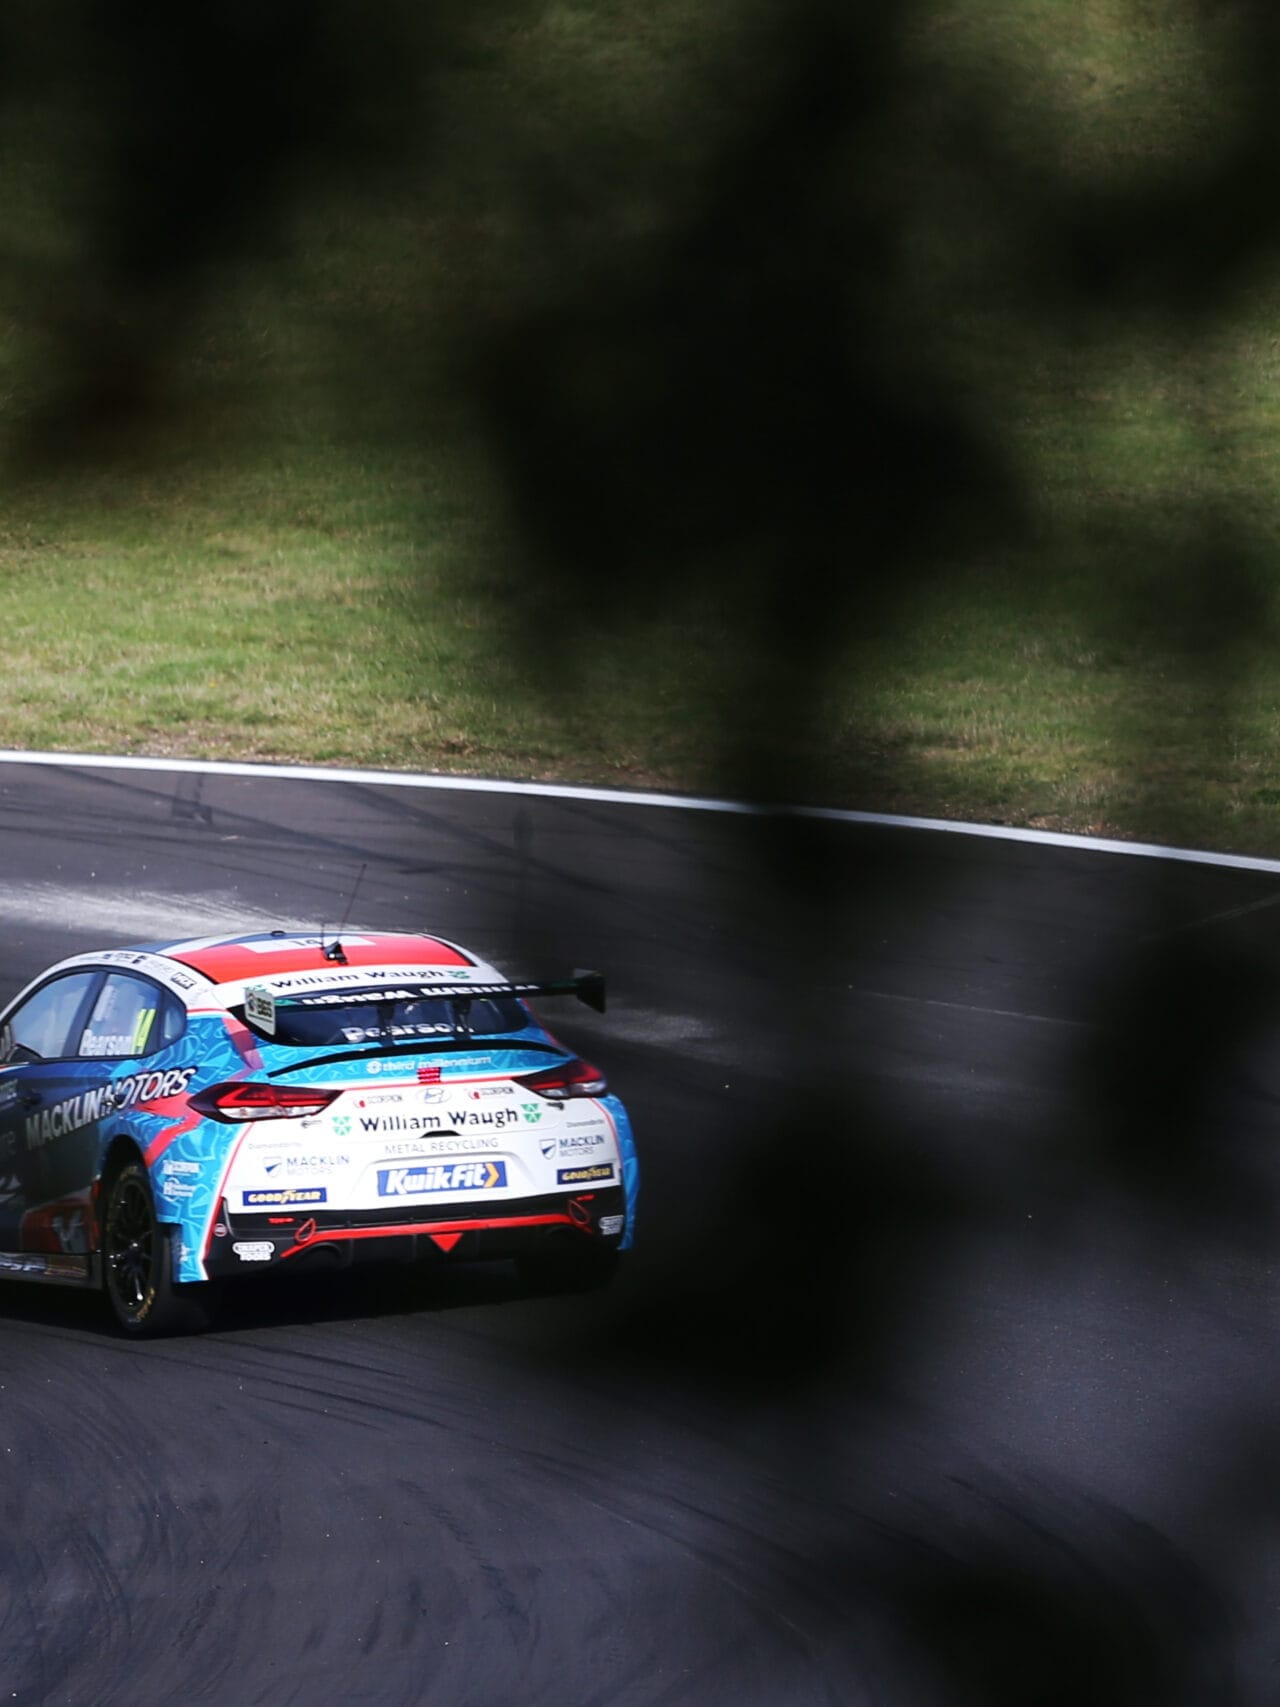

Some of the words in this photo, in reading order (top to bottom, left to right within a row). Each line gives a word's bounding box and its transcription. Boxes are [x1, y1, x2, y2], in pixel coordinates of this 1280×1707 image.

[271, 972, 358, 989] William
[365, 968, 444, 981] Waugh
[25, 1086, 107, 1149] MACKLIN
[101, 1067, 196, 1118] MOTORS
[360, 1114, 441, 1133] William
[447, 1107, 519, 1129] Waugh
[384, 1142, 425, 1154] METAL
[431, 1136, 499, 1151] RECYCLING
[558, 1134, 605, 1149] MACKLIN
[285, 1154, 350, 1167] MACKLIN
